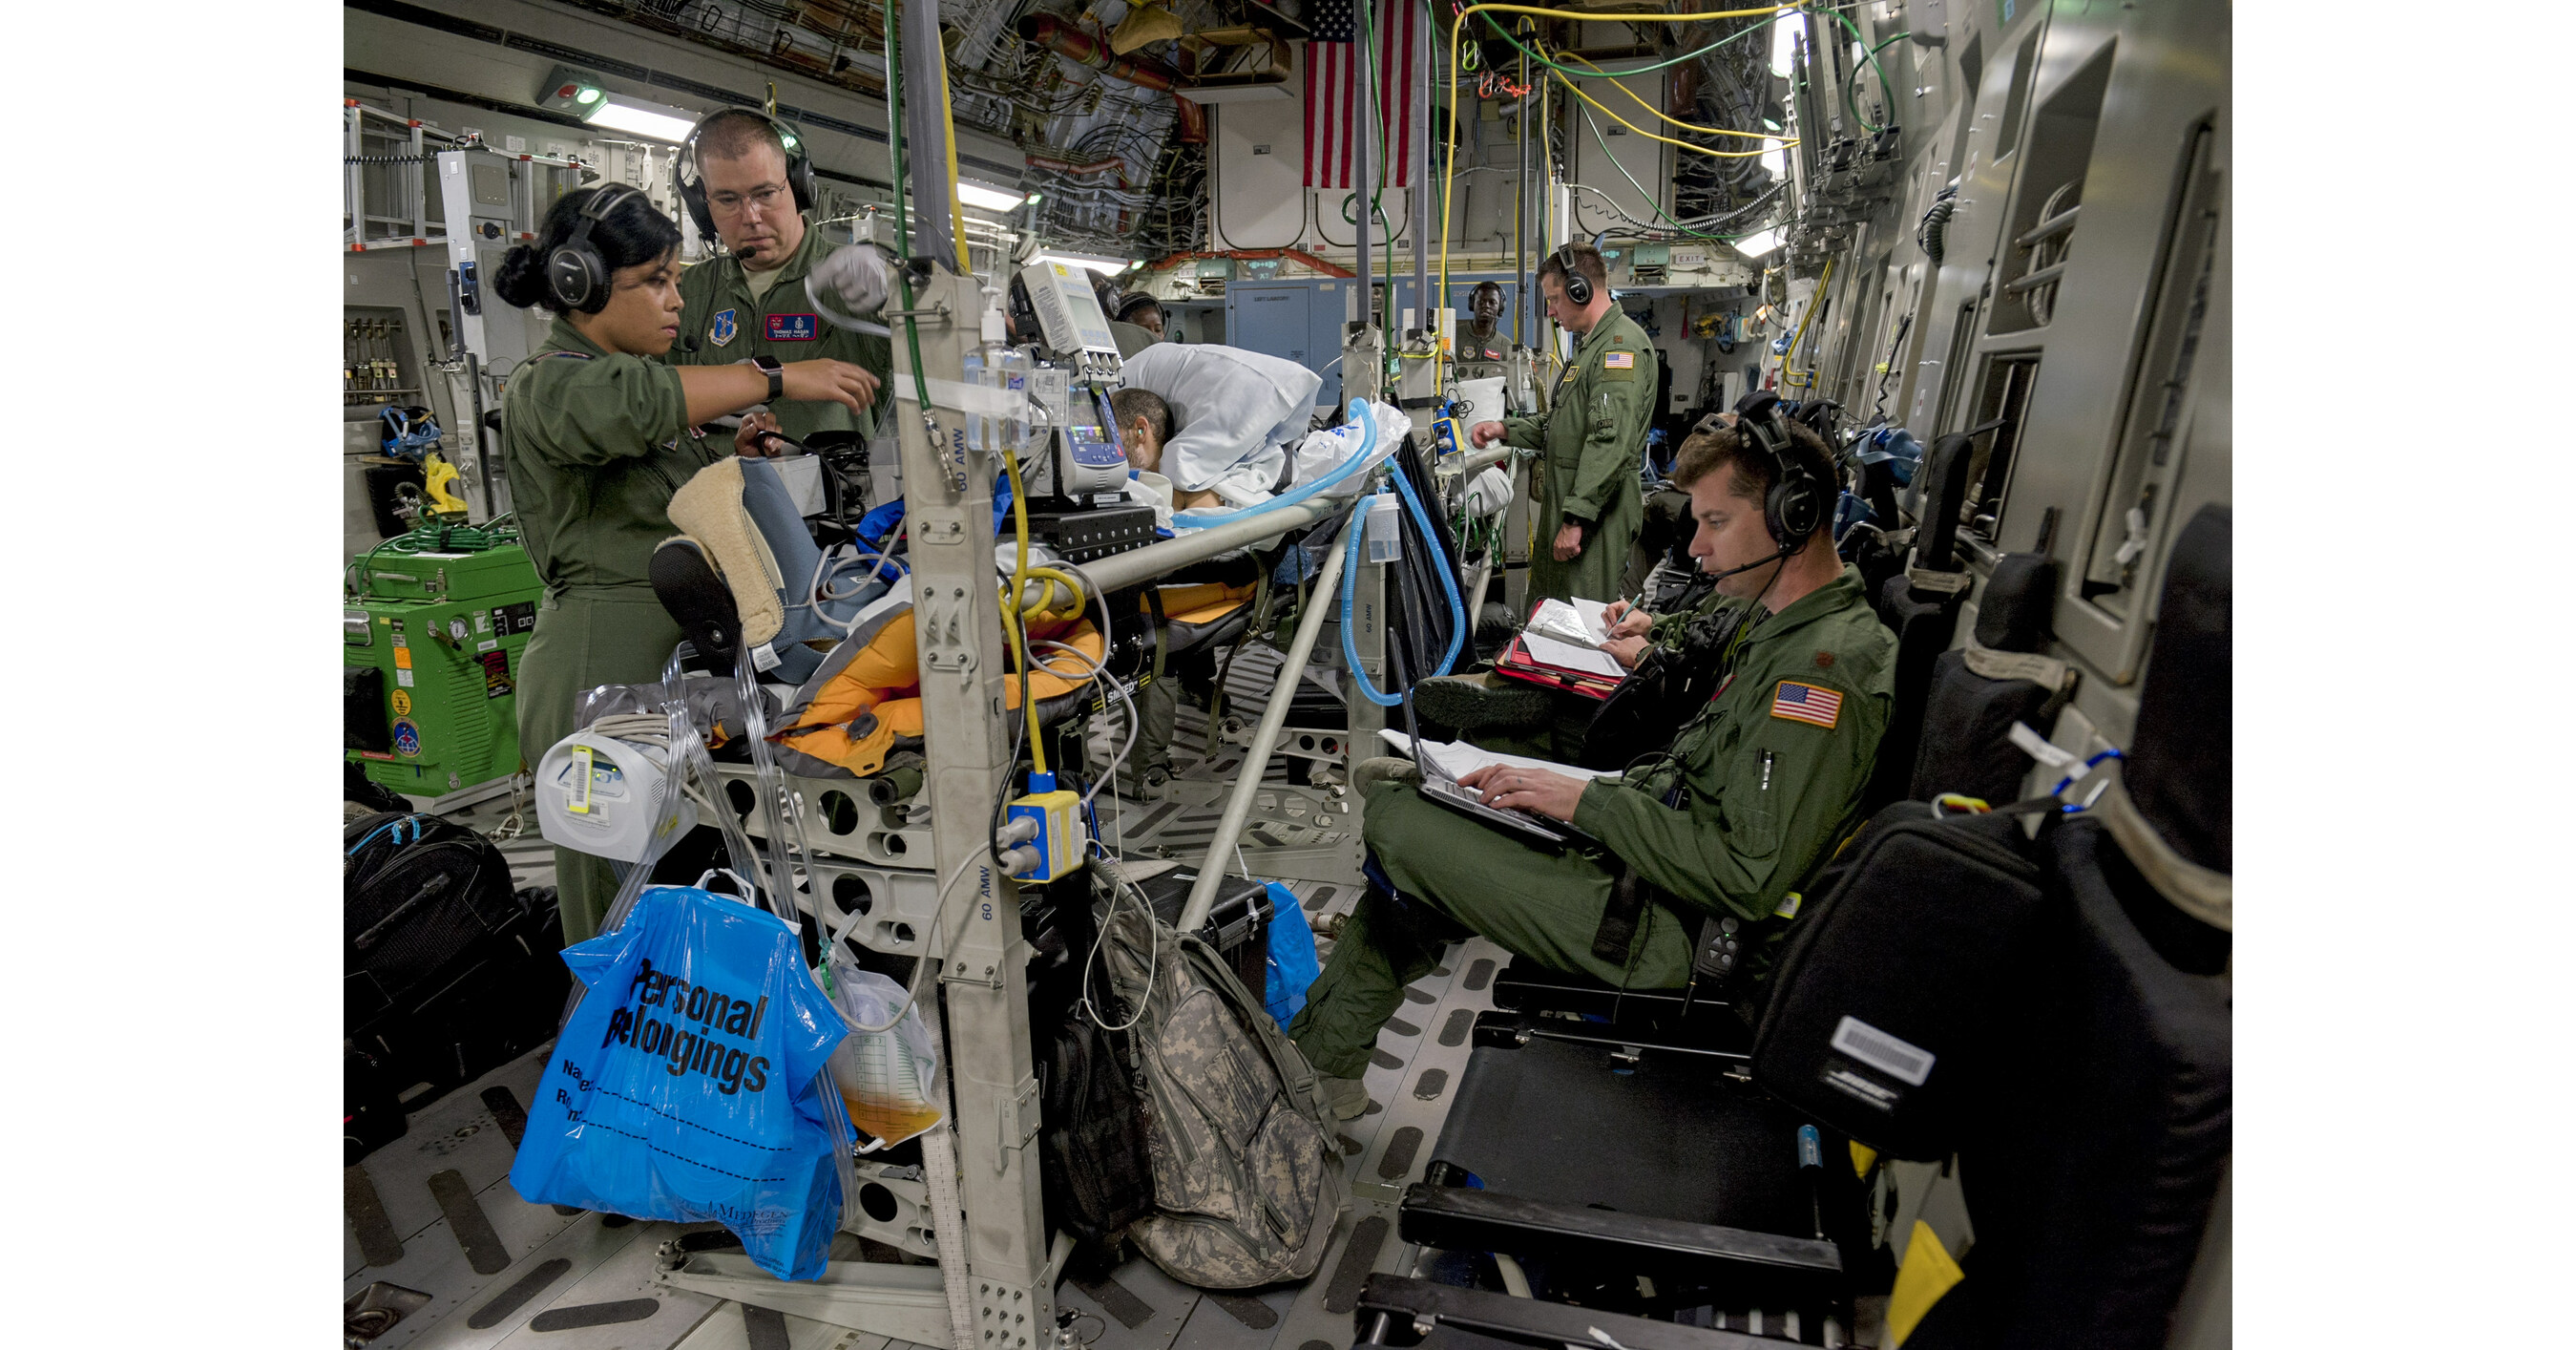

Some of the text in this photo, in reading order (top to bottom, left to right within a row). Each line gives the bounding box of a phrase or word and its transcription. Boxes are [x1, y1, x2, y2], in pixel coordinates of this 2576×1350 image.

[953, 428, 968, 492] 60 AMW
[1107, 680, 1135, 704] SMED
[979, 865, 993, 921] 60 AMW
[629, 958, 769, 1041] Personal
[562, 1059, 595, 1091] Nae:
[600, 1004, 770, 1096] Belongings
